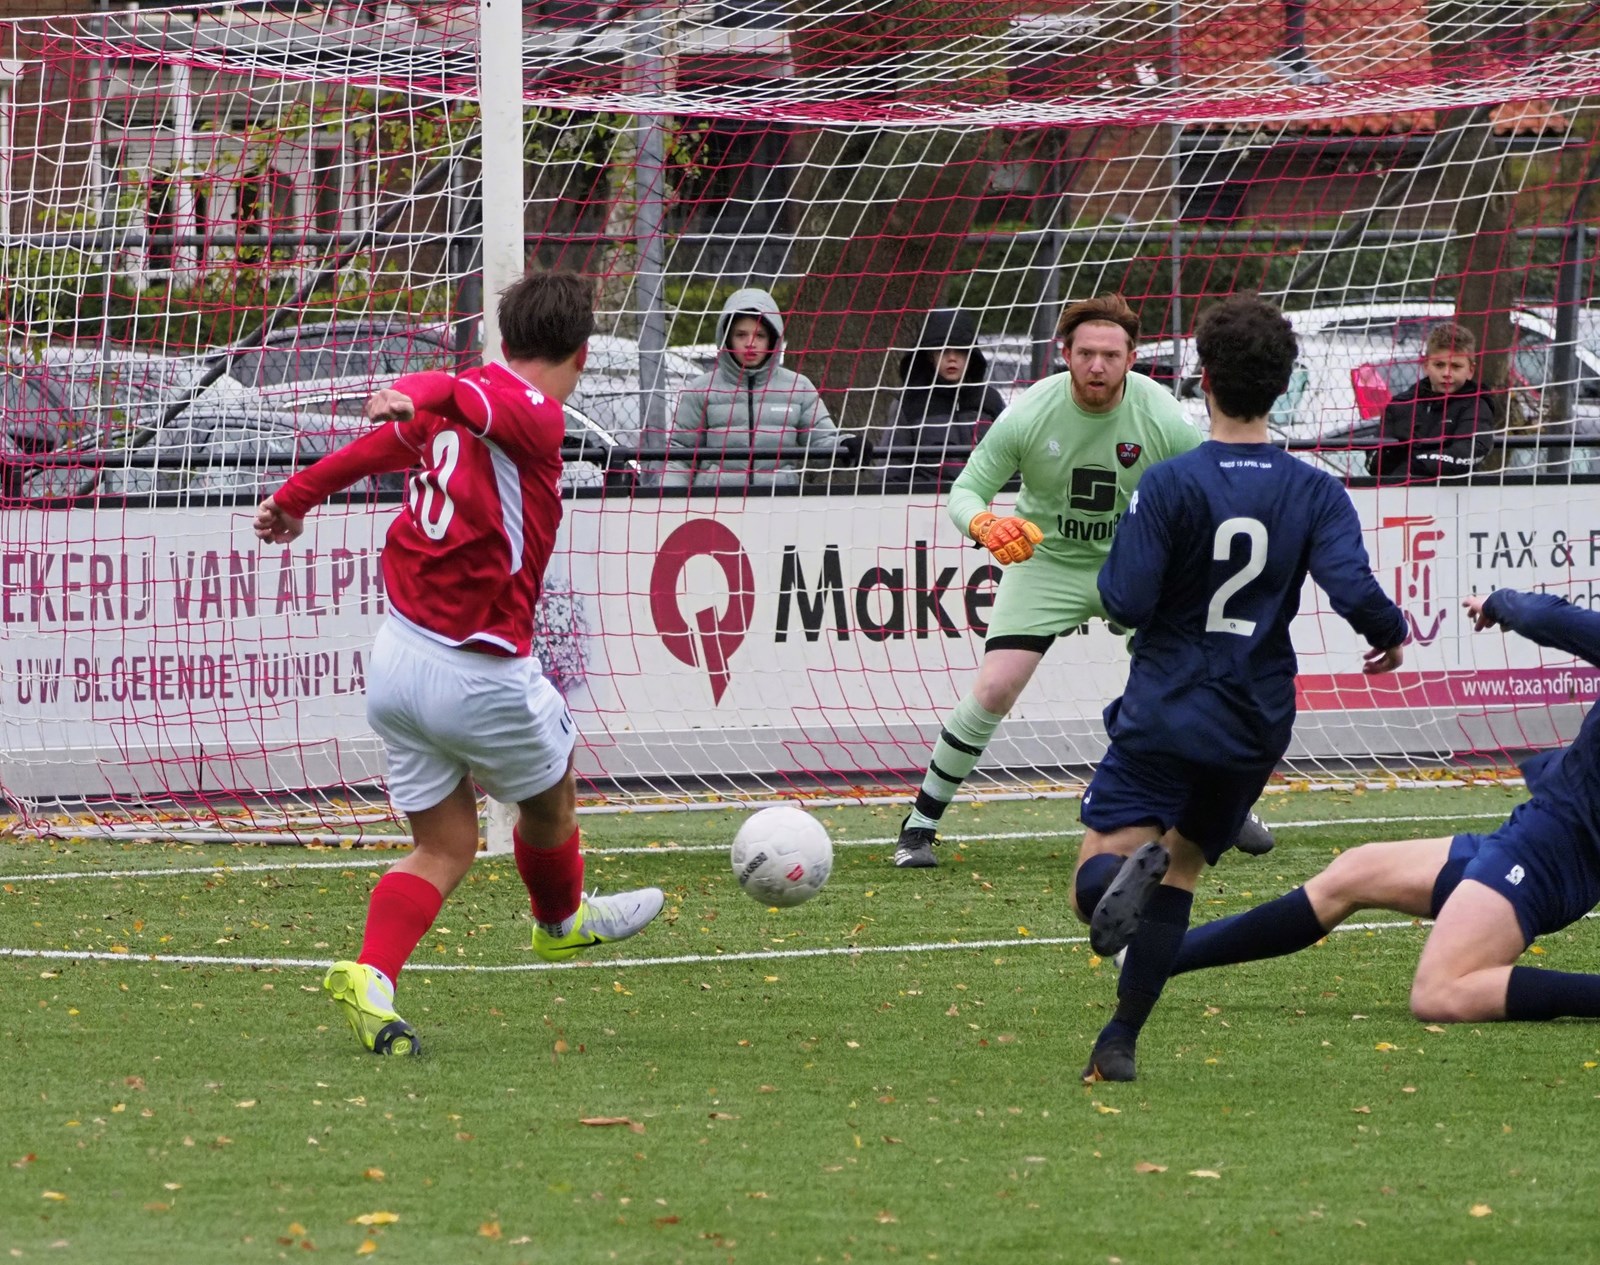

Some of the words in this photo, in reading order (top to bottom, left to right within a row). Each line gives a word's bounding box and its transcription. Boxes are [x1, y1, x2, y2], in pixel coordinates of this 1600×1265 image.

[1206, 517, 1269, 637] 2
[1469, 531, 1538, 569] TAX
[1550, 530, 1575, 568] &
[169, 549, 256, 619] VAN
[275, 547, 385, 616] ALPH
[16, 658, 61, 704] UW
[244, 650, 372, 698] TUINPLA
